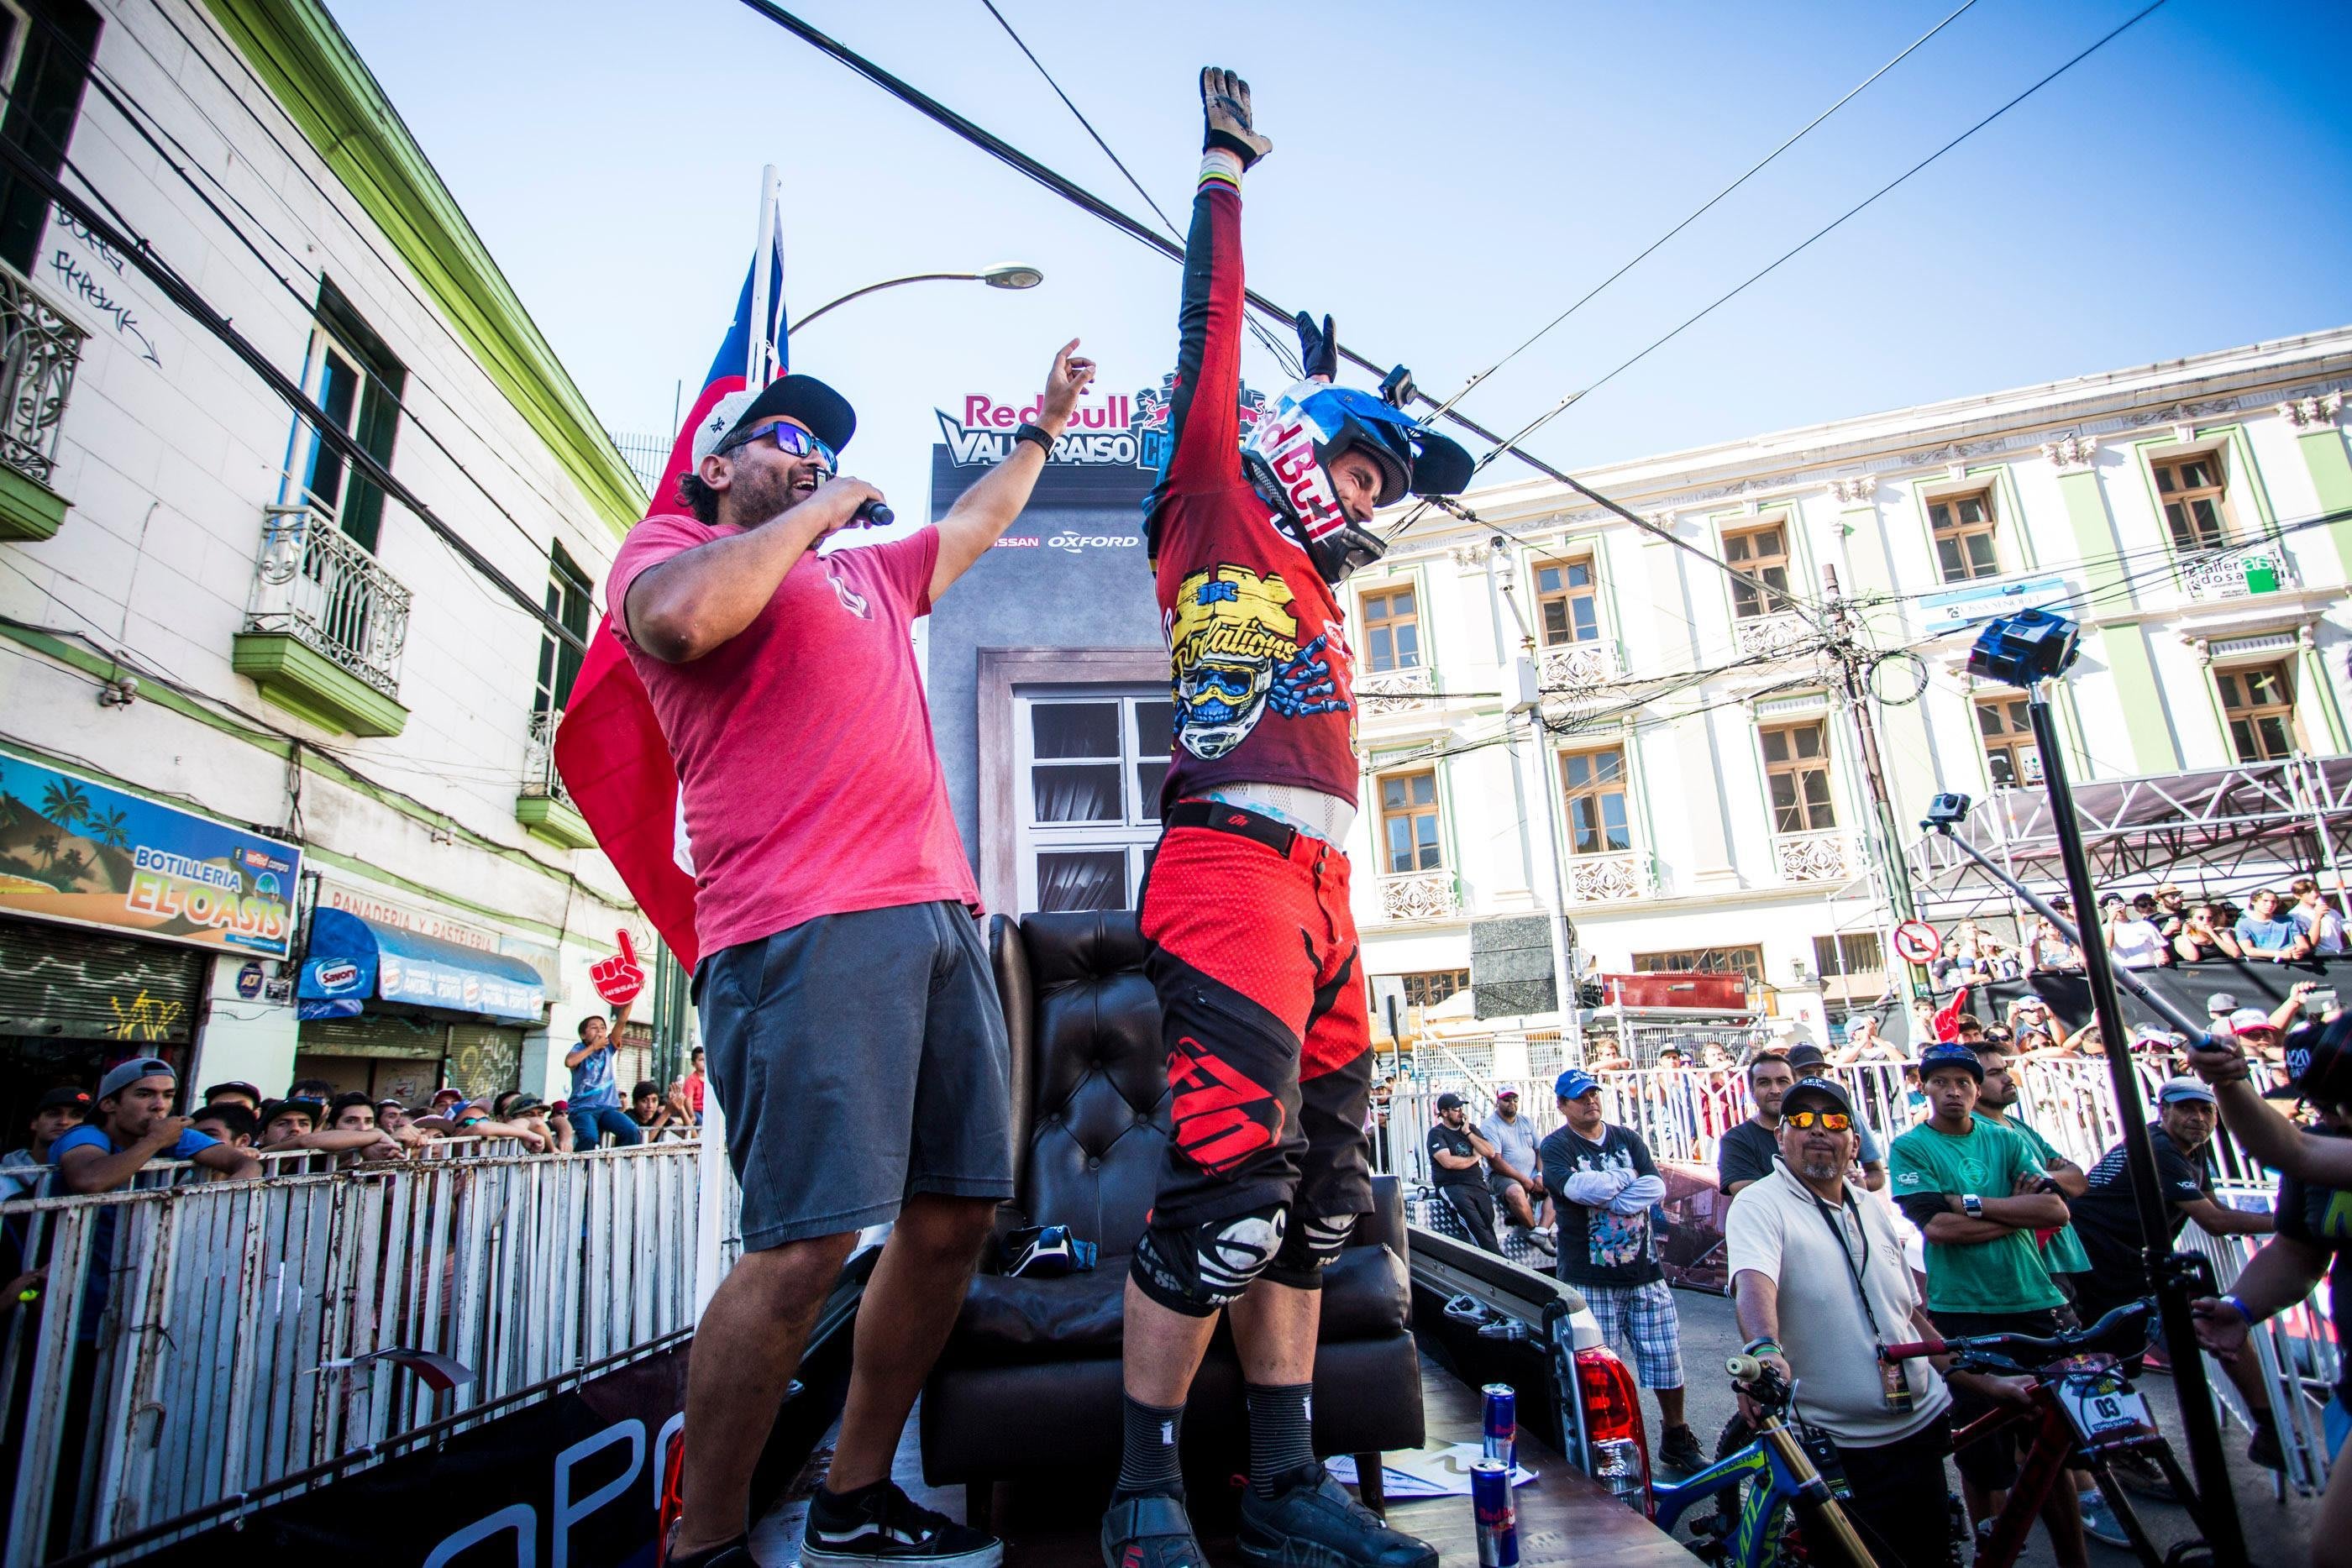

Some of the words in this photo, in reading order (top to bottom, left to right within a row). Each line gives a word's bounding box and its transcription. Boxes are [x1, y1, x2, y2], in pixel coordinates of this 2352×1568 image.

[965, 395, 1044, 427] Red
[1047, 532, 1140, 552] OXFORD
[135, 847, 242, 892] BOTILLERIA
[129, 871, 176, 915] EL
[186, 886, 284, 938] OASIS
[332, 891, 411, 930] PANADERIA
[419, 918, 427, 932] Y
[433, 922, 492, 952] PASTELERIA
[323, 968, 357, 983] Savory
[2094, 1397, 2121, 1419] 03
